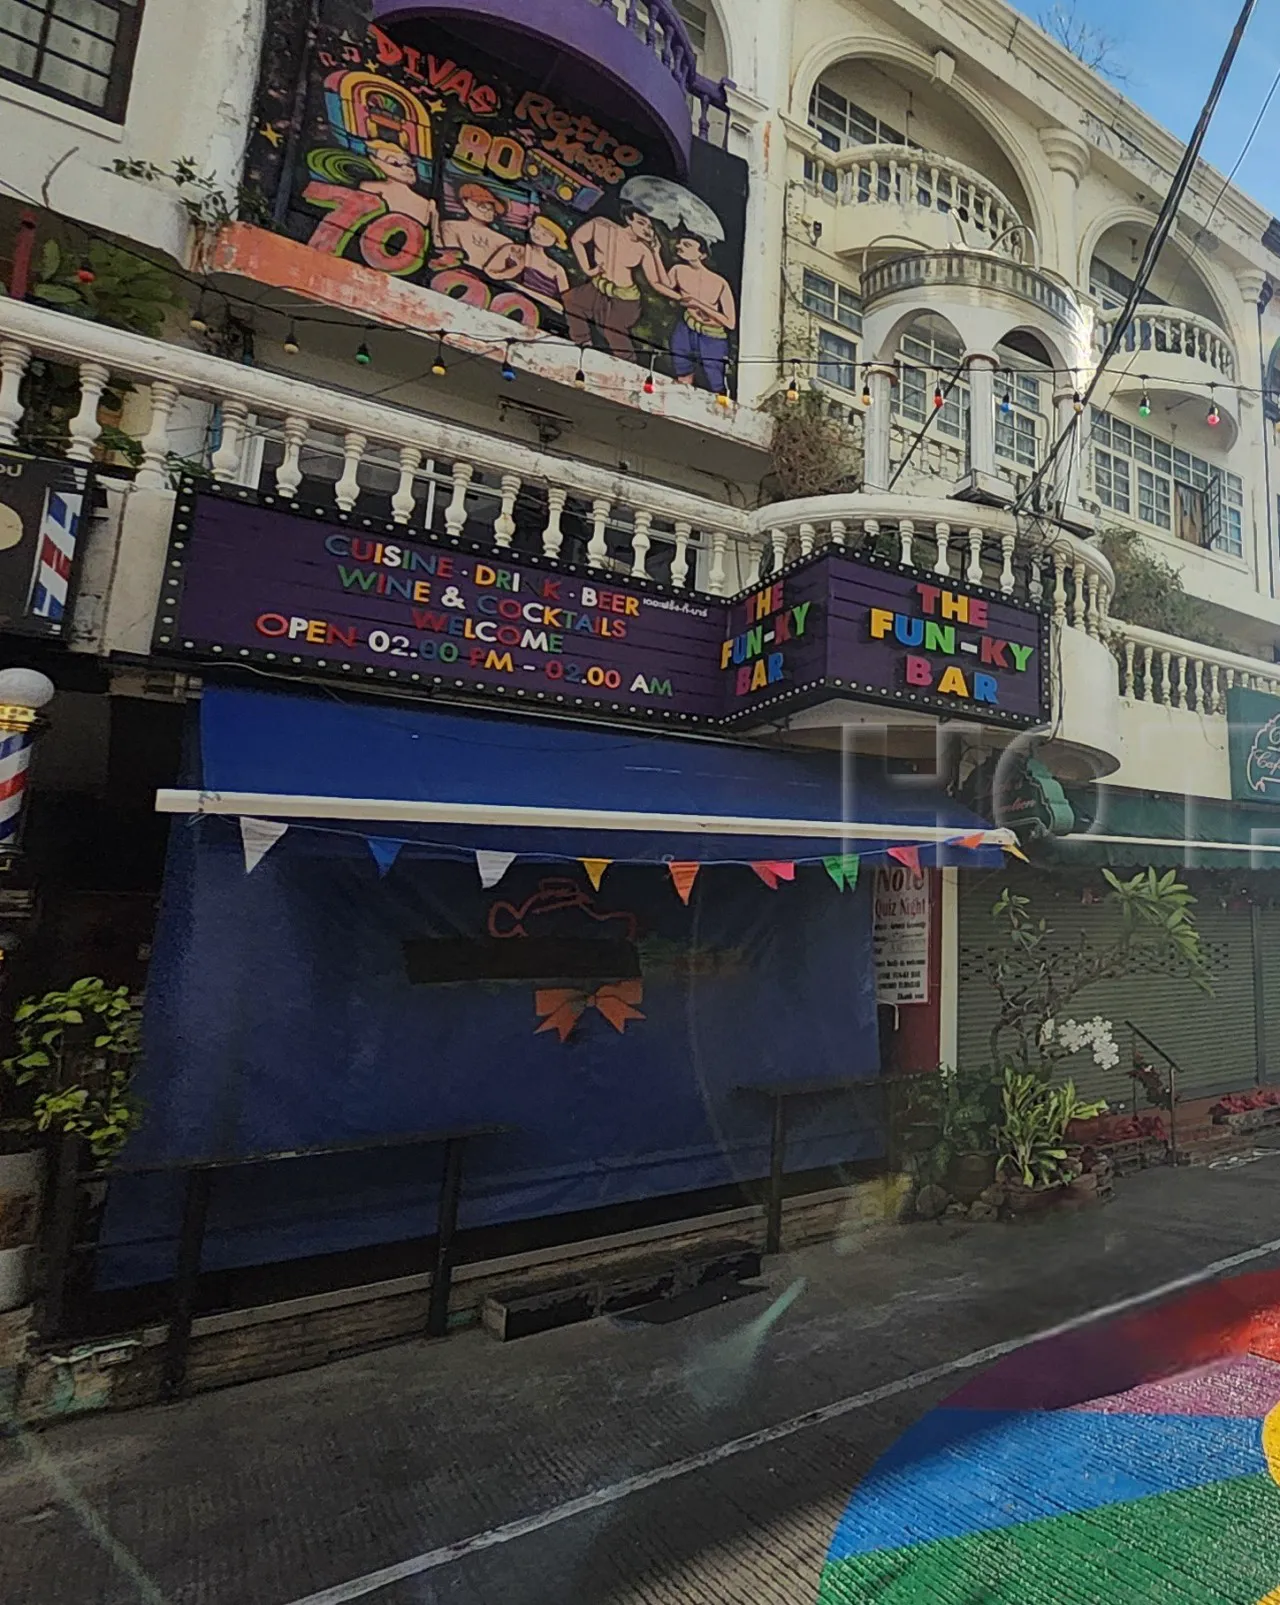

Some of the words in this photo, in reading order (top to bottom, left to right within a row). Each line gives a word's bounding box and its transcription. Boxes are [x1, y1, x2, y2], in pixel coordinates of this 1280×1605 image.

[368, 22, 499, 116] DIVAS
[453, 123, 525, 180] 80
[514, 91, 643, 166] Retro
[325, 534, 453, 578] CUISINE
[475, 564, 561, 599] DRIK
[581, 586, 640, 617] BEER
[337, 564, 432, 603] WINE
[441, 586, 466, 609] &
[478, 594, 626, 638] COCKTAILS
[746, 580, 784, 624] THE
[917, 583, 988, 628] THE
[256, 613, 357, 649] OPEN
[368, 630, 458, 663] 02.00
[469, 648, 514, 673] PM
[630, 674, 673, 697] AM
[411, 608, 564, 654] WELCOME
[720, 601, 810, 669] FUN-KY
[871, 608, 1034, 672] FUN-KY
[736, 652, 783, 696] BAR
[906, 654, 999, 704] BAR
